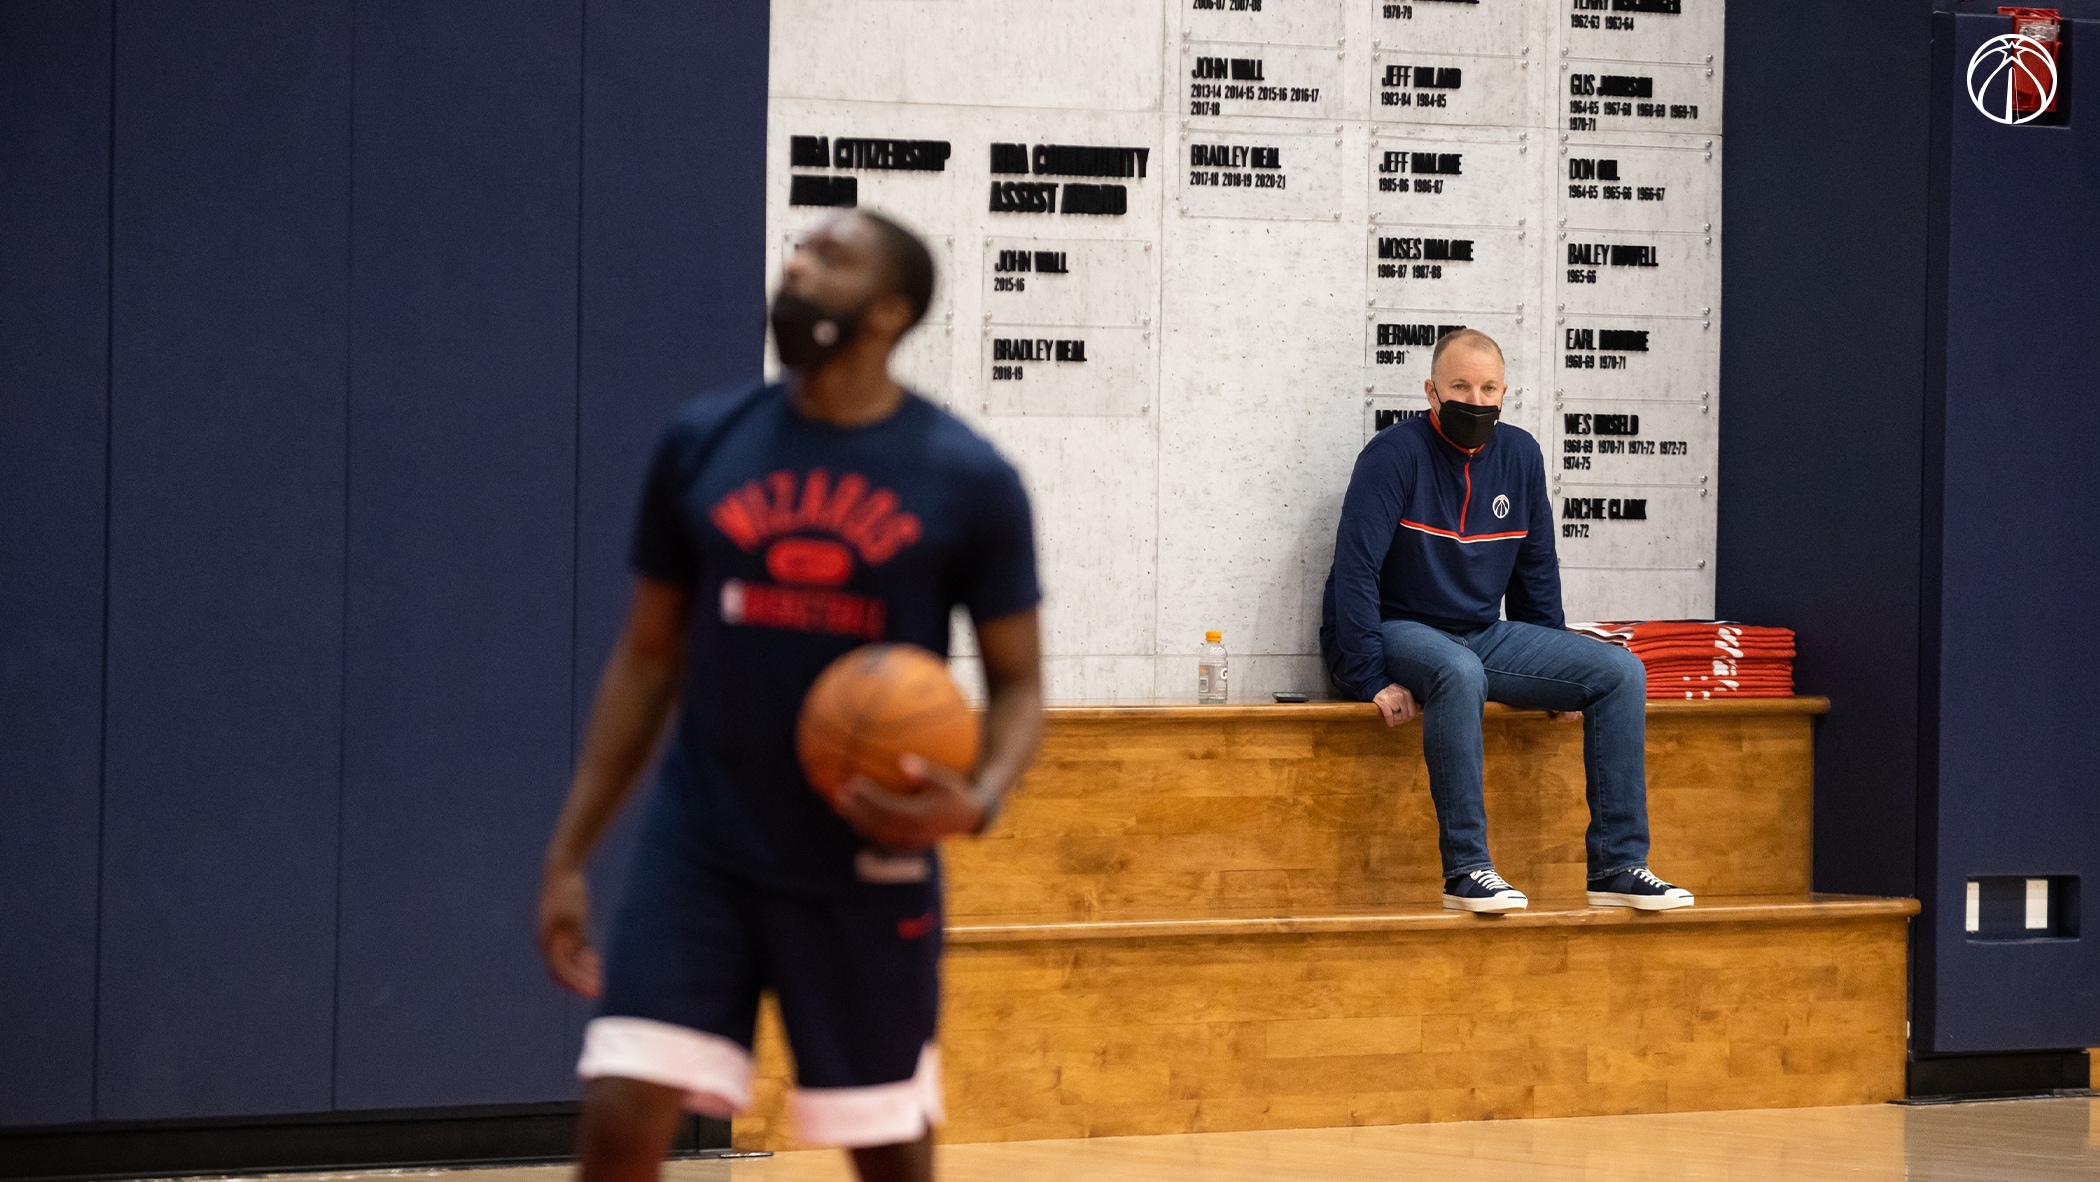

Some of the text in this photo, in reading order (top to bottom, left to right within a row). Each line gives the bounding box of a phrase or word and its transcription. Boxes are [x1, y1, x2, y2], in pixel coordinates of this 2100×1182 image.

[1383, 5, 1412, 19] 1978-79
[1192, 57, 1228, 80] JOHN
[1382, 65, 1412, 87] JEFF
[1191, 84, 1319, 102] 2013-14 2014-15 2015-16 2016-17
[1570, 74, 1595, 96] GUS
[1191, 101, 1220, 115] 2017-18
[1381, 92, 1446, 108] 1983-84 1984-85
[1191, 145, 1249, 168] BRADLEY
[1379, 152, 1409, 173] JEFF
[1569, 158, 1595, 180] DON
[1190, 171, 1218, 186] 2017-18
[1255, 174, 1285, 189] 2020-21
[989, 181, 1058, 214] ASSIST
[1569, 185, 1598, 199] 1964-65
[1379, 238, 1422, 260] MOSES
[1568, 244, 1610, 266] BAILEY
[995, 250, 1031, 272] JOHN
[994, 277, 1024, 291] 2015-16
[1377, 324, 1436, 347] BERNARD
[1566, 329, 1596, 350] EARL
[994, 339, 1053, 361] BRADLEY
[1376, 350, 1404, 364] 1990-91
[993, 366, 1023, 380] 2018-19
[1564, 414, 1594, 435] WES
[1564, 456, 1590, 470] 1974-75
[711, 470, 920, 565] WIZARDS
[1562, 524, 1589, 538] 1971-72
